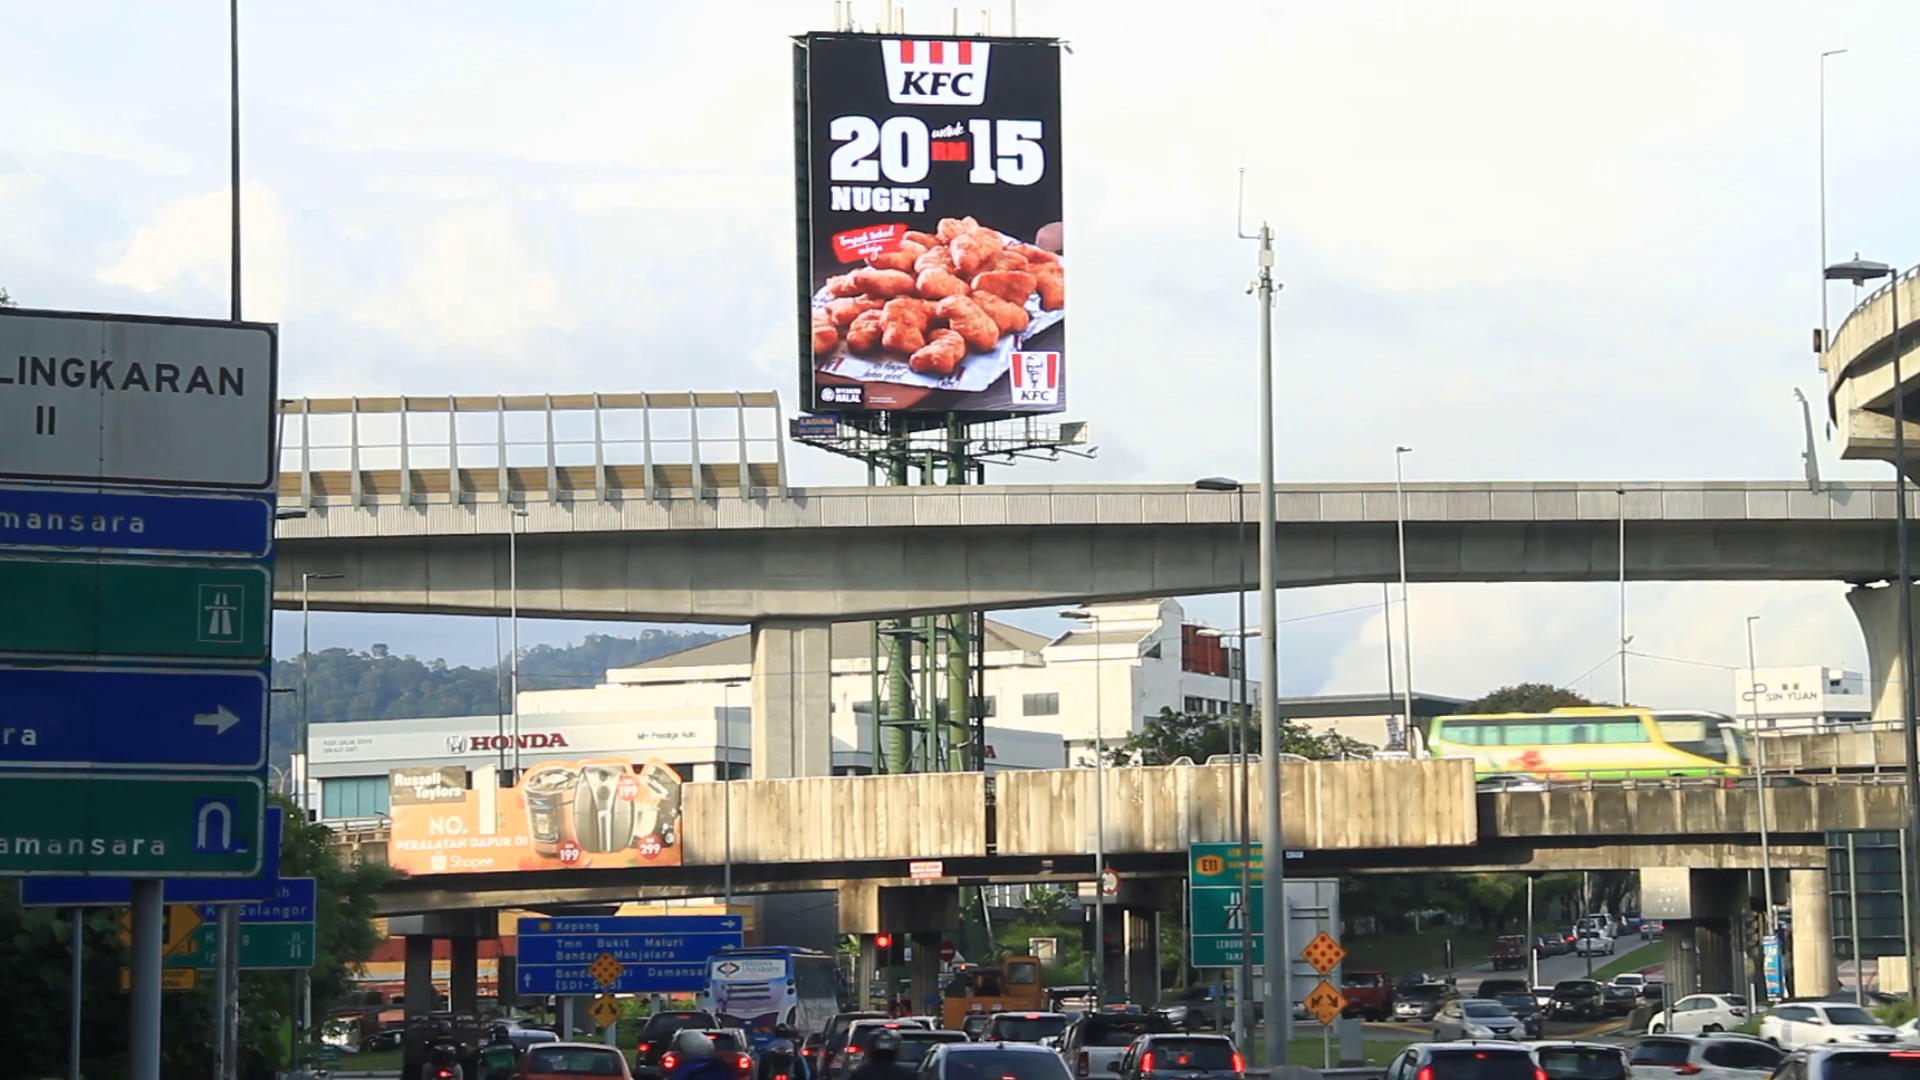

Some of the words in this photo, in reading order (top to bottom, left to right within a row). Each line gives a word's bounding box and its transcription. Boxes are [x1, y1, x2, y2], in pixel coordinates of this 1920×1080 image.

[900, 71, 974, 97] KFC
[829, 115, 930, 183] 20
[968, 118, 1045, 186] 15
[830, 186, 930, 212] NUGET
[1021, 390, 1050, 401] KFC
[470, 733, 569, 751] HONDA
[394, 772, 442, 787] Russell
[414, 785, 462, 801] Taylors
[619, 785, 639, 797] 199
[429, 816, 469, 836] NO.
[396, 838, 466, 851] PERALATAN
[470, 837, 511, 848] DAPUR
[515, 836, 528, 847] DI
[640, 843, 661, 855] 299
[450, 854, 494, 870] Shopee
[559, 848, 579, 861] 199
[1202, 858, 1218, 872] E11
[240, 904, 307, 919] Selangor
[556, 922, 600, 932] Kepong
[556, 939, 582, 948] Tmn
[597, 938, 630, 948] Bukit
[645, 938, 683, 947] Maluri
[556, 951, 598, 961] Bandar
[614, 951, 675, 962] Manjalara
